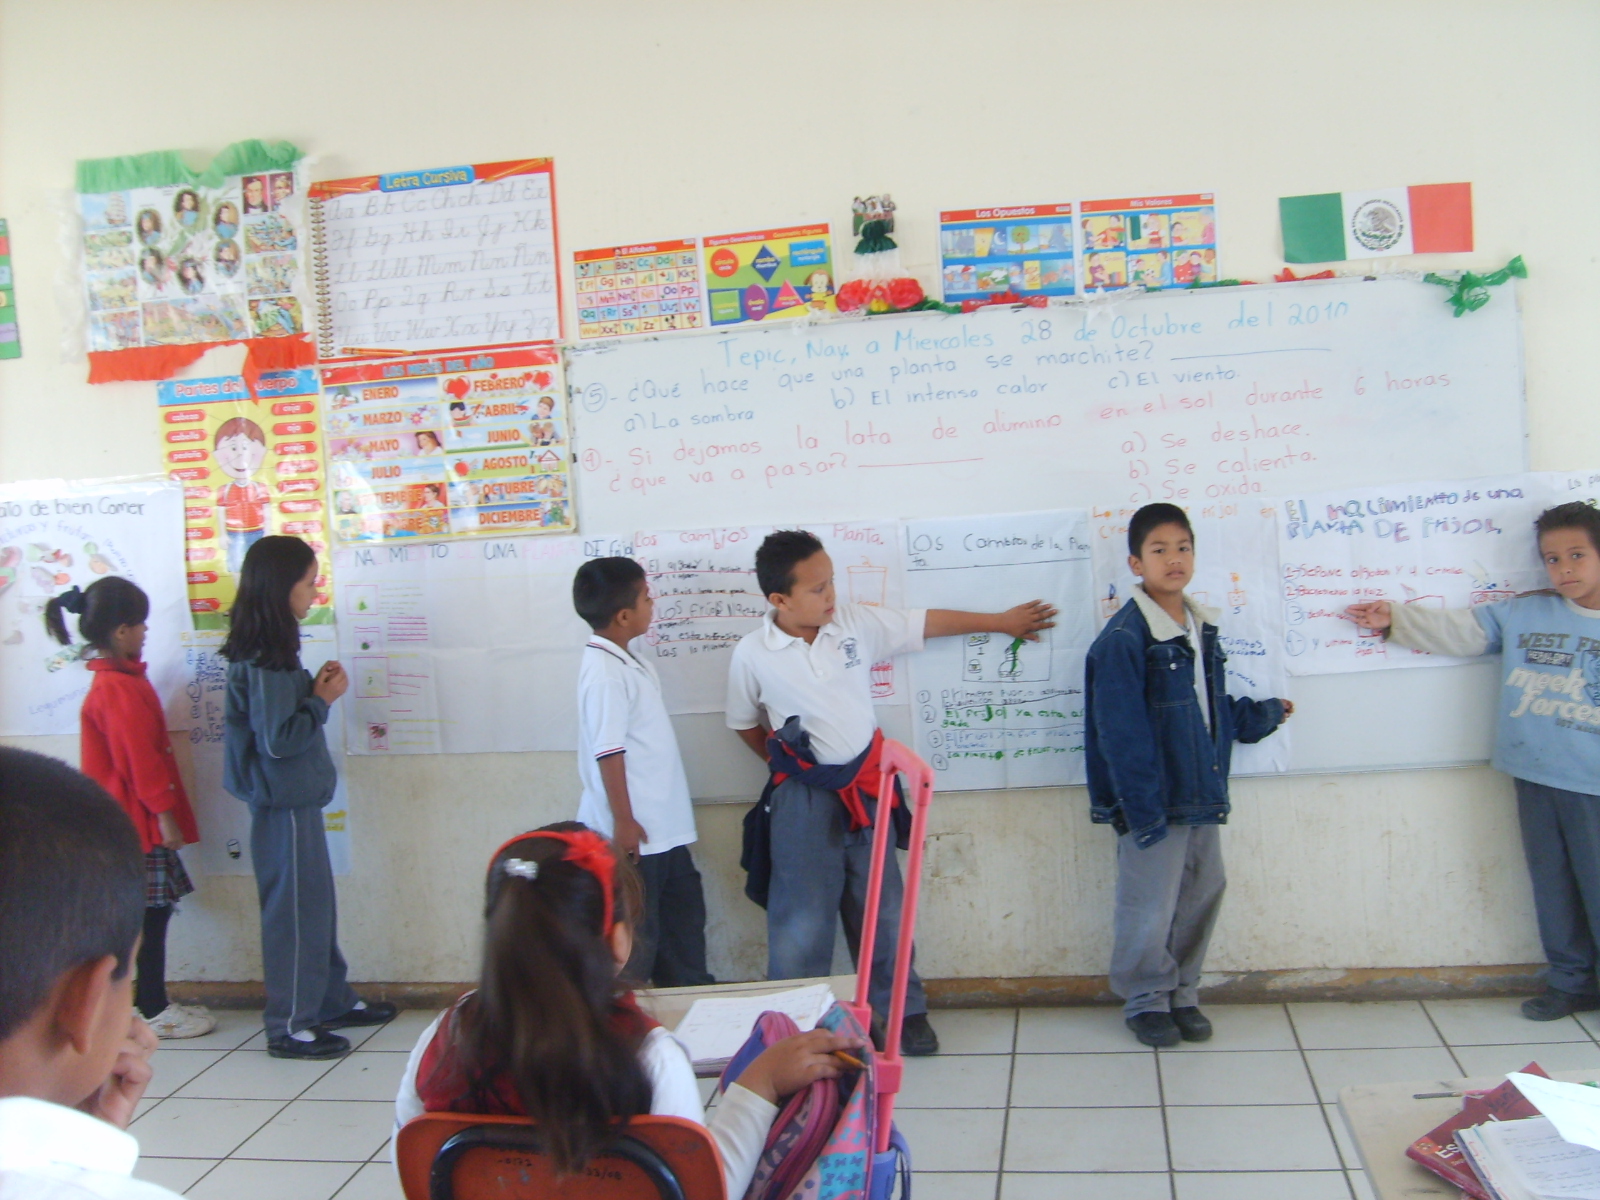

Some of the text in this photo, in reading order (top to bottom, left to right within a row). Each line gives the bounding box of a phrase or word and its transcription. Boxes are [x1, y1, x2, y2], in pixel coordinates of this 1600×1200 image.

[385, 169, 468, 189] Letra Cursiva
[976, 205, 1036, 219] Los Opuestos
[1144, 198, 1173, 206] Valores
[663, 285, 695, 296] Oo Pp
[717, 338, 797, 369] Tepic,
[865, 341, 879, 354] a
[894, 329, 994, 352] Miercoles
[1021, 321, 1053, 346] 28
[1074, 315, 1100, 342] de
[1111, 313, 1203, 341] Octubre
[1228, 303, 1274, 330] del
[703, 367, 749, 395] hace
[779, 366, 816, 389] que
[832, 365, 865, 381] una
[890, 354, 957, 383] planta
[987, 353, 1014, 369] se
[1036, 340, 1155, 368] marchite?
[174, 382, 220, 397] Partes
[255, 376, 298, 392] uerpo
[362, 376, 526, 400] ENERO FEBRERO
[870, 388, 891, 406] El
[907, 382, 979, 404] intenso
[996, 374, 1049, 397] calor
[362, 402, 519, 426] MARZO ABRIL
[629, 444, 653, 467] Si
[673, 437, 763, 466] dejamos
[796, 424, 819, 449] la
[843, 420, 892, 445] lata
[932, 415, 958, 440] de
[1100, 403, 1130, 421] en
[1143, 396, 1167, 415] el
[1180, 389, 1215, 411] sol
[1244, 382, 1324, 407] durante
[1352, 376, 1367, 398] 6
[1384, 369, 1452, 391] horas
[690, 402, 755, 426] sombra
[368, 428, 521, 453] MAYO JUNIO
[1160, 427, 1188, 451] Se
[371, 454, 528, 481] JULIO AGOSTO
[688, 467, 714, 484] va
[731, 465, 746, 481] a
[764, 451, 849, 490] pasar?
[1165, 456, 1198, 478] Se
[482, 479, 535, 496] OCTUBRE
[1160, 478, 1190, 500] Se
[29, 500, 51, 517] de
[55, 496, 94, 515] bien
[98, 496, 145, 516] Comer
[479, 508, 541, 526] DICIEMBRE
[1284, 499, 1310, 524] El
[1485, 487, 1525, 502] una
[1373, 518, 1414, 544] DE
[1516, 631, 1572, 650] WEST
